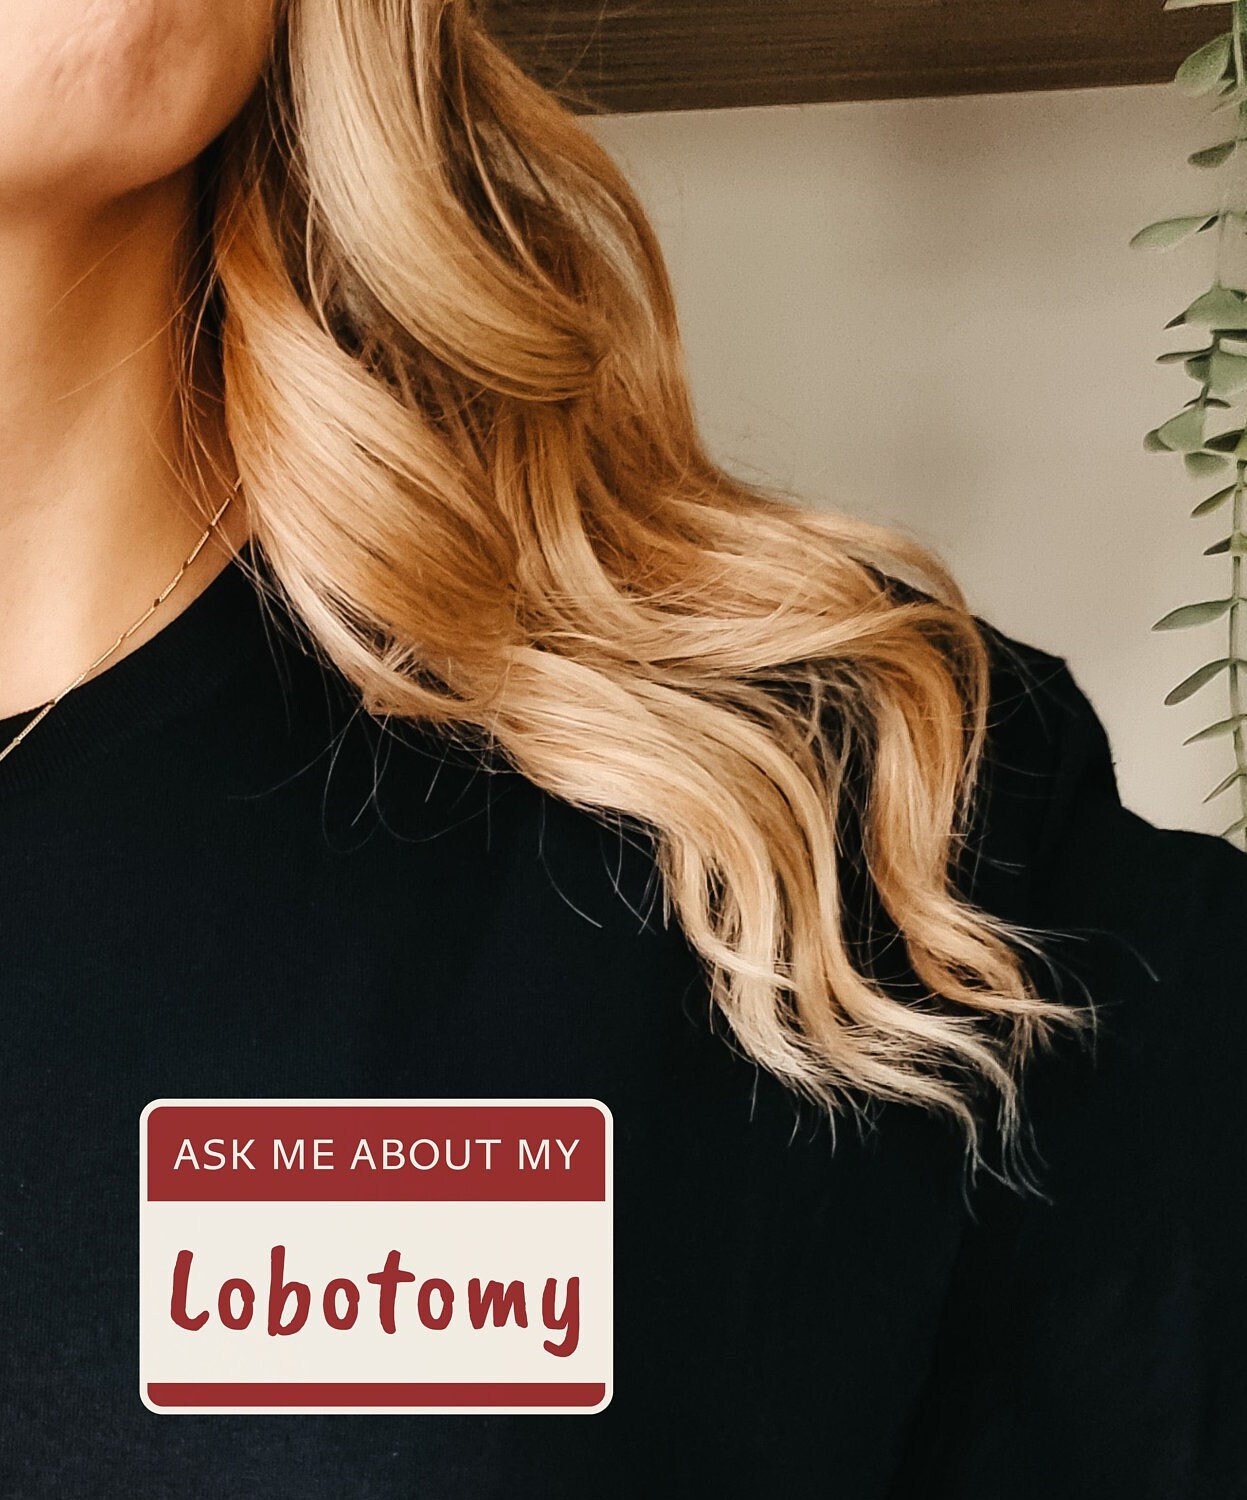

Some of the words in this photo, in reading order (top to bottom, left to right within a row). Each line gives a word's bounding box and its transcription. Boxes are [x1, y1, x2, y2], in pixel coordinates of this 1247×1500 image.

[173, 1138, 256, 1171] ASK
[273, 1138, 334, 1170] ME
[349, 1138, 502, 1171] ABOUT
[518, 1138, 580, 1170] MY
[170, 1244, 580, 1358] Lobotomy
